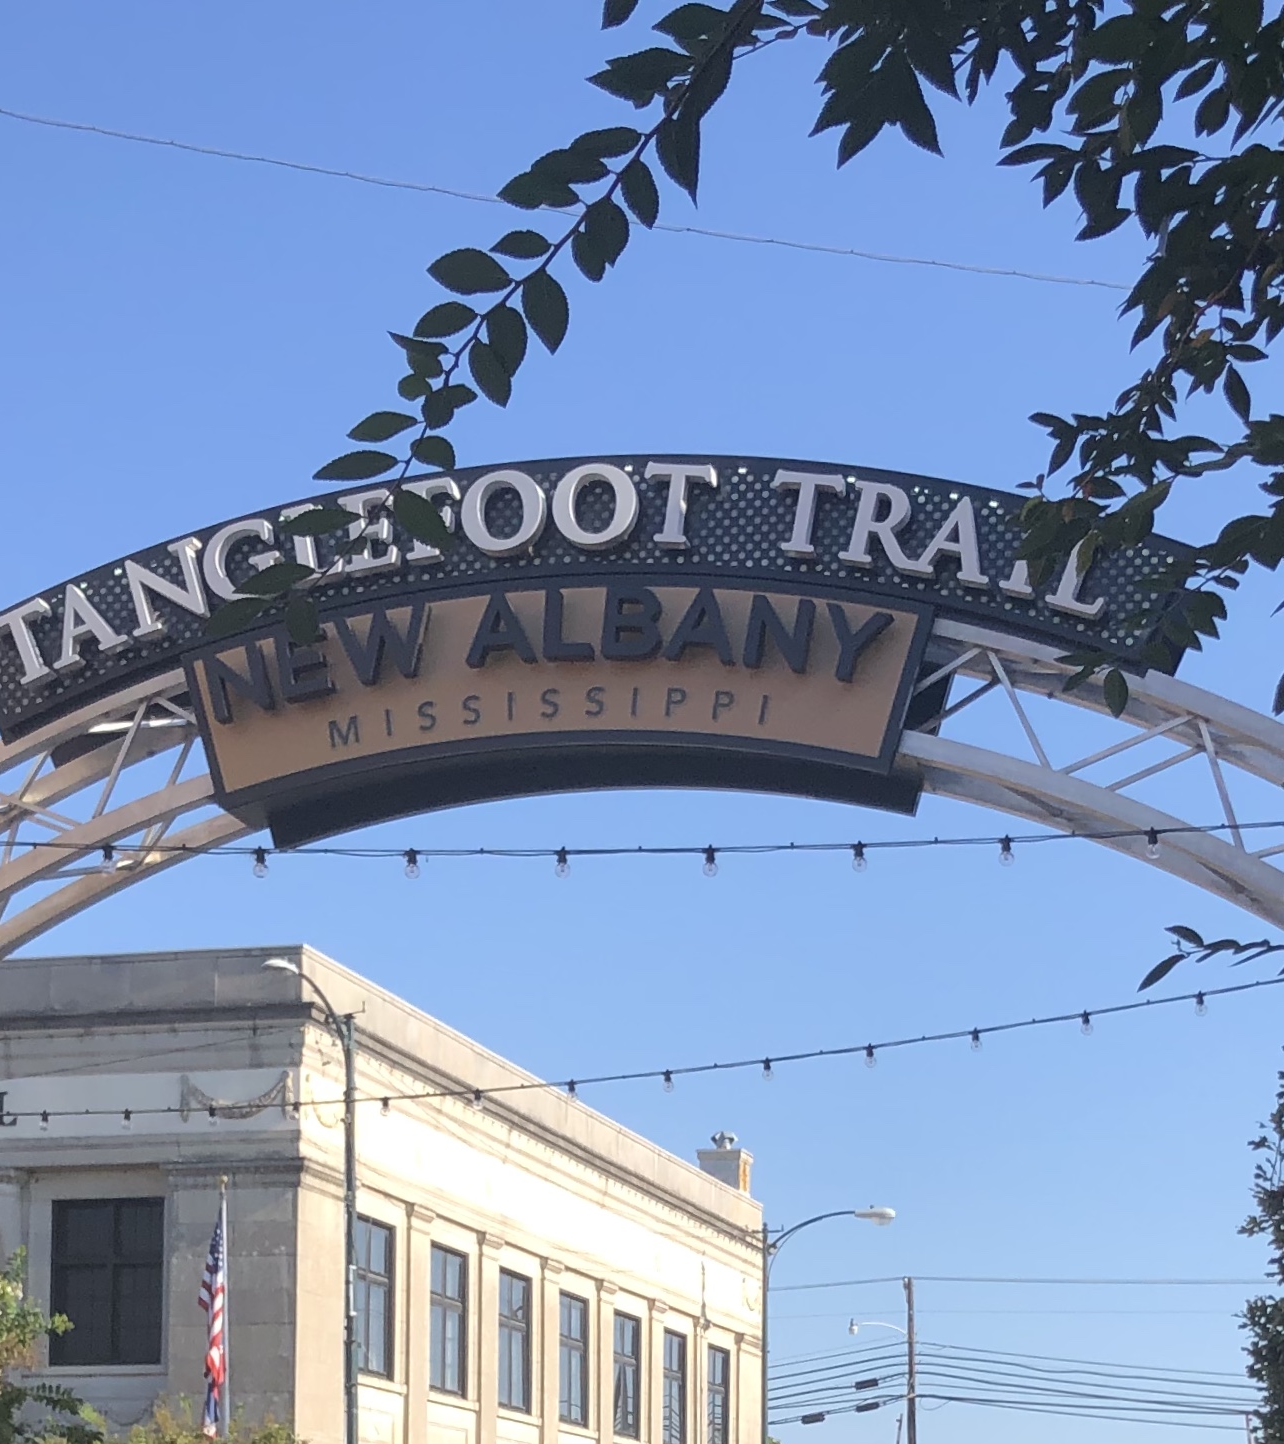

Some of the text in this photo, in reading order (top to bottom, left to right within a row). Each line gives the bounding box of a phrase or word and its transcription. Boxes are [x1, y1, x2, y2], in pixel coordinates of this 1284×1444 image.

[200, 585, 894, 724] NEW ALBANY
[328, 685, 771, 750] MISSISSIPPI
